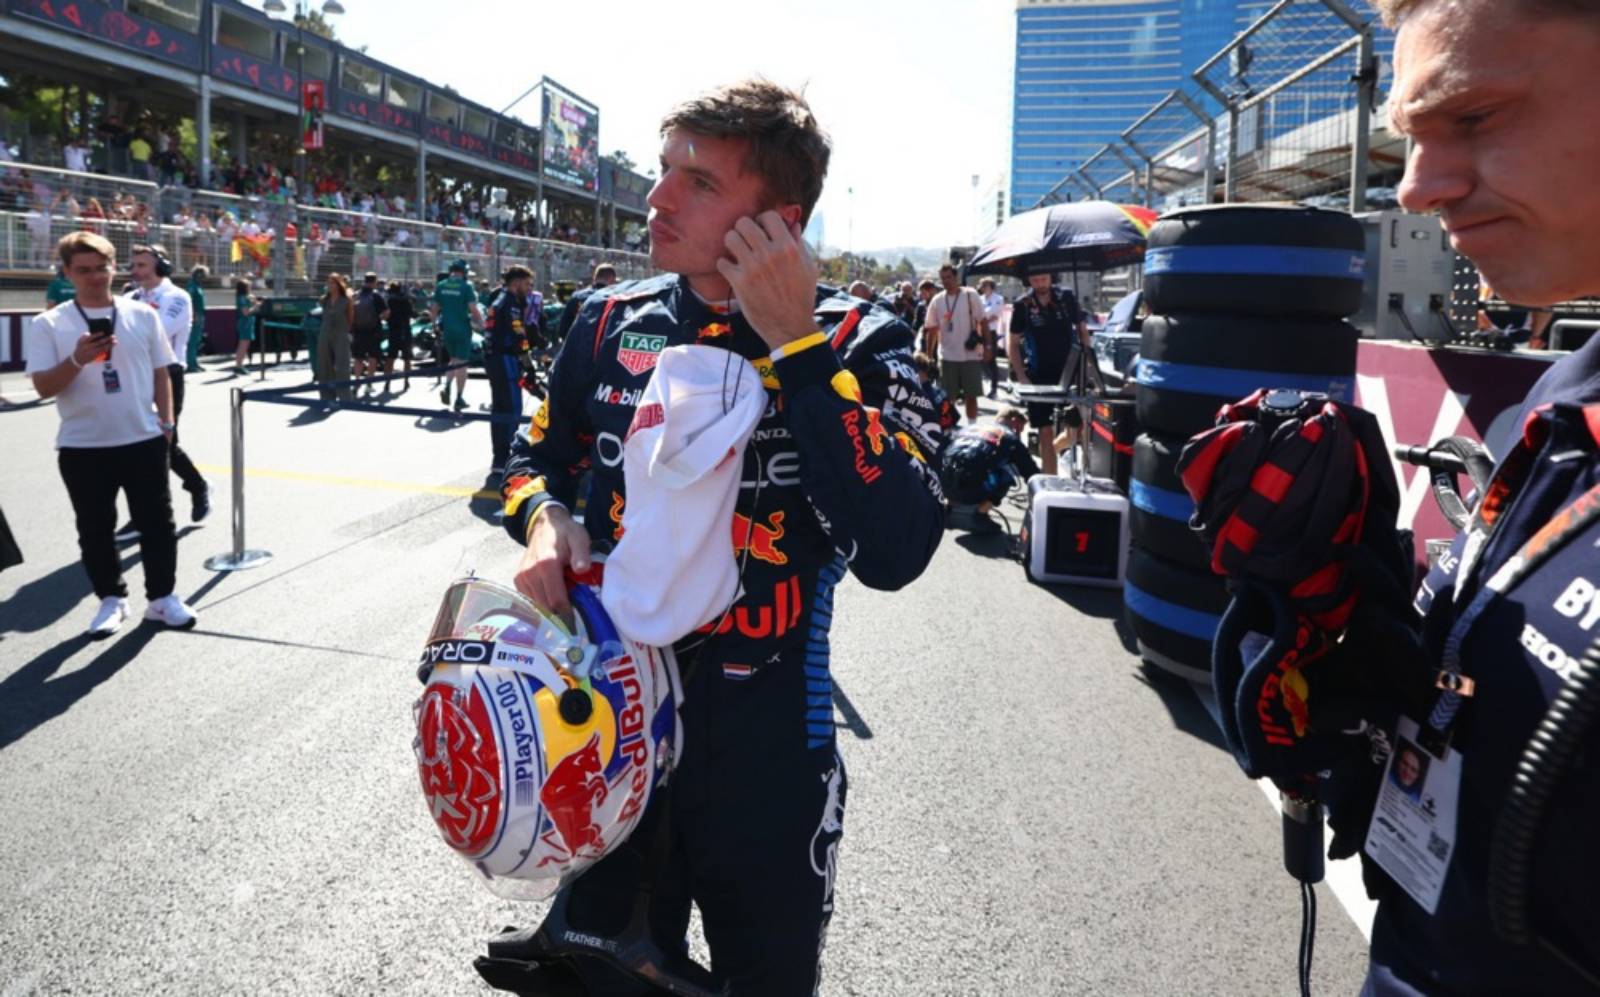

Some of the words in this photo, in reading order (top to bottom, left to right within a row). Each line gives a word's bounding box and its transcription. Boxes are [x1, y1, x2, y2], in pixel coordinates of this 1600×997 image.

[626, 335, 662, 351] TAG
[594, 383, 643, 407] Mobil
[508, 708, 535, 782] Player
